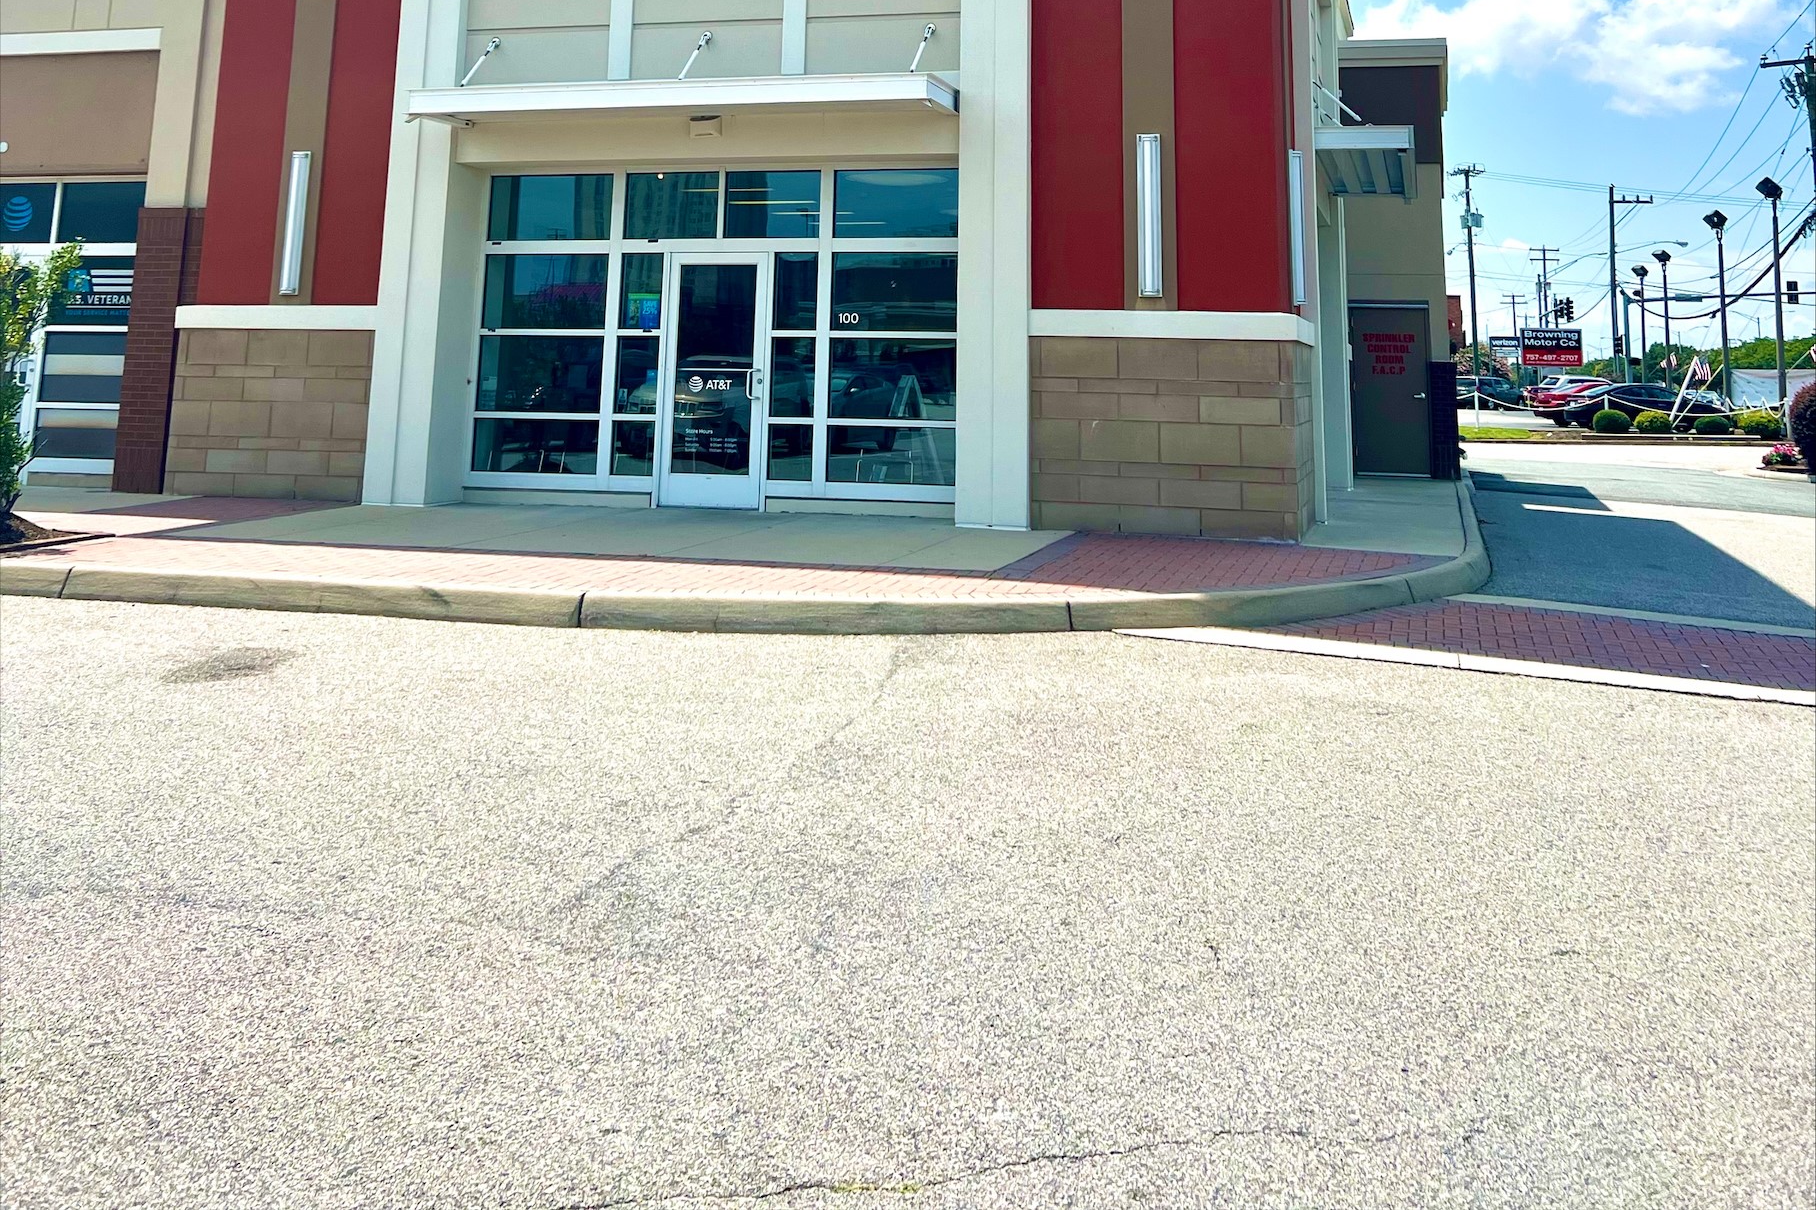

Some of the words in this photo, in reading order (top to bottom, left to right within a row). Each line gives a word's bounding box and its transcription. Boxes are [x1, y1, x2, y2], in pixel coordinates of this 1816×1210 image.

[838, 312, 859, 324] 100
[1362, 333, 1415, 343] SPRINKLER
[1524, 330, 1578, 340] Browning
[1524, 338, 1558, 346] Motor
[1367, 344, 1411, 353] CONTROL
[1375, 355, 1404, 364] ROOM
[1372, 365, 1406, 374] F.A.C.P
[706, 380, 732, 390] AT&T
